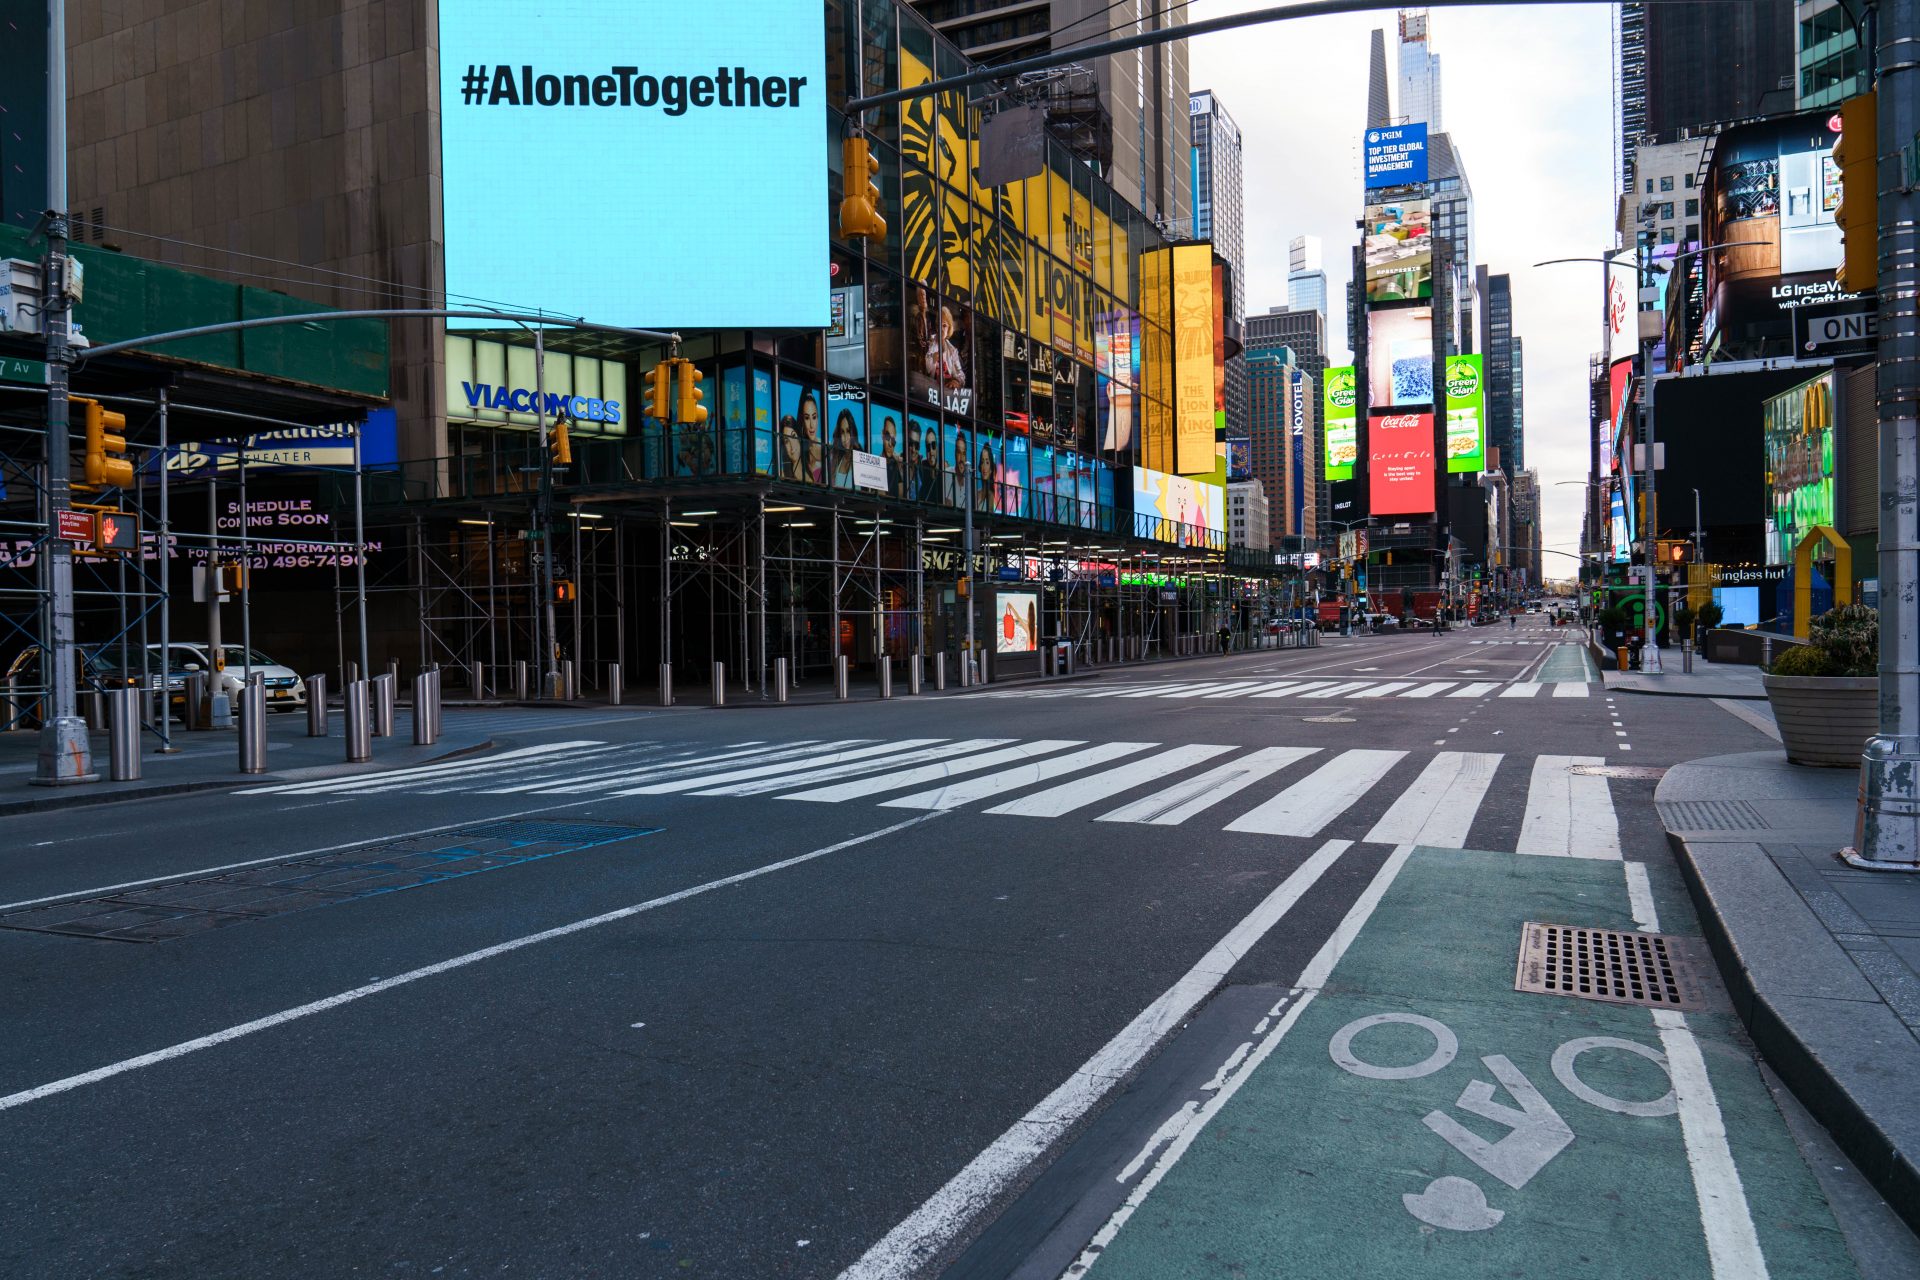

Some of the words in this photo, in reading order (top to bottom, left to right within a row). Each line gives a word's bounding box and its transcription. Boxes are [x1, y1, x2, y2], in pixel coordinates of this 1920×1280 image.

[461, 65, 807, 116] #AloneTogether
[1381, 131, 1402, 140] PGIM
[1368, 147, 1381, 155] TOP
[1383, 145, 1397, 154] TIER
[1399, 142, 1424, 152] GLOBAL
[1369, 152, 1408, 164] INVESTMENT
[1369, 160, 1413, 173] MANAGEMENT
[1063, 212, 1092, 263] THE
[1034, 235, 1081, 321] LION
[1771, 284, 1793, 299] LG
[1794, 280, 1842, 296] InstaVi
[1778, 300, 1800, 310] with
[1823, 315, 1879, 340] ONE
[1184, 385, 1205, 395] THE
[1446, 379, 1476, 388] Green
[1333, 390, 1355, 398] Gree
[1449, 386, 1477, 395] Giant
[461, 381, 621, 424] VIACOMCBS
[1180, 398, 1209, 414] LION
[1293, 378, 1303, 435] NOVOTEL
[1335, 397, 1355, 405] Gian
[1178, 416, 1213, 435] KING
[245, 451, 312, 464] THEATER
[1711, 569, 1763, 584] sunglass
[1765, 569, 1785, 579] hut
